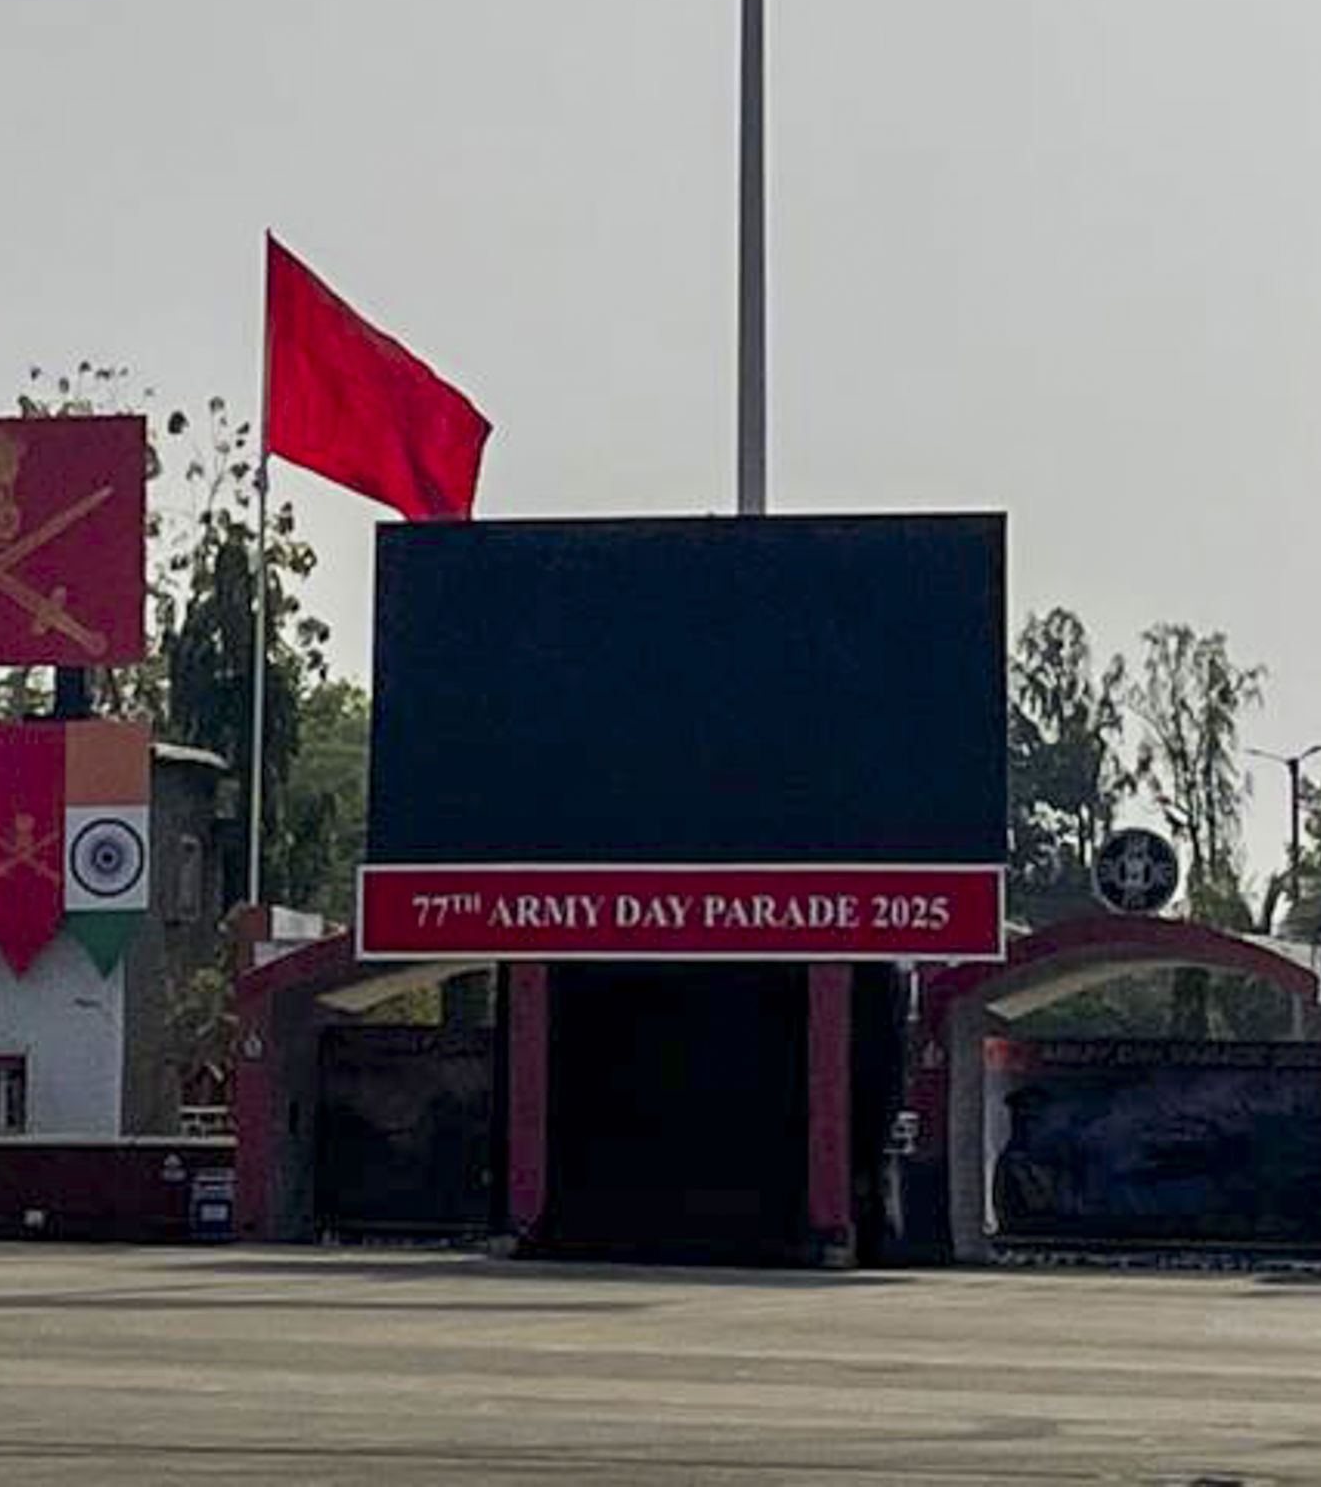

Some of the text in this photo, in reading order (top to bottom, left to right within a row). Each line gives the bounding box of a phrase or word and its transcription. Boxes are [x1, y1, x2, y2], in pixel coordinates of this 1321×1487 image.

[413, 893, 950, 929] 77TH ARMY DAY PARADE 2025
